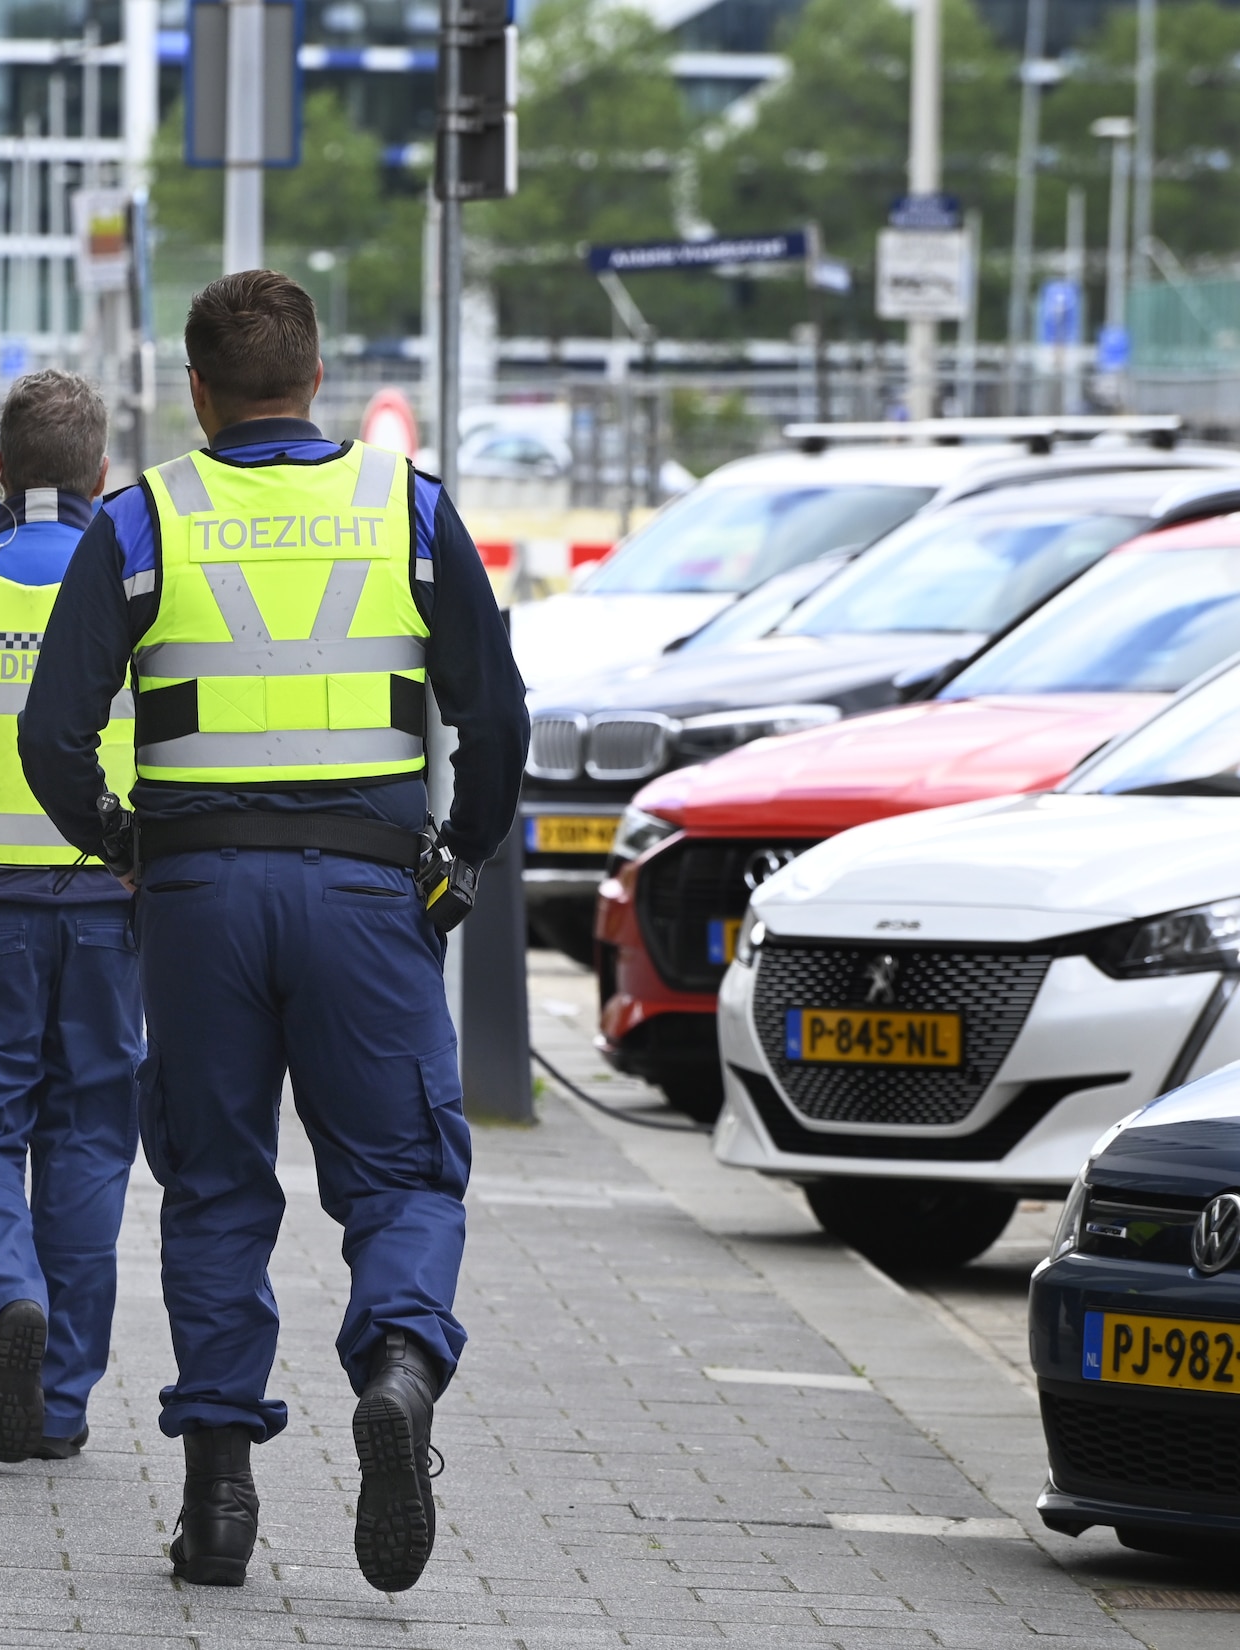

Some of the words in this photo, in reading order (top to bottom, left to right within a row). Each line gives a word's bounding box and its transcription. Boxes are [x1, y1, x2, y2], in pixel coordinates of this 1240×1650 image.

[194, 515, 384, 550] TOEZICHT
[810, 1016, 949, 1058] P-845-NL
[1086, 1352, 1100, 1368] NL
